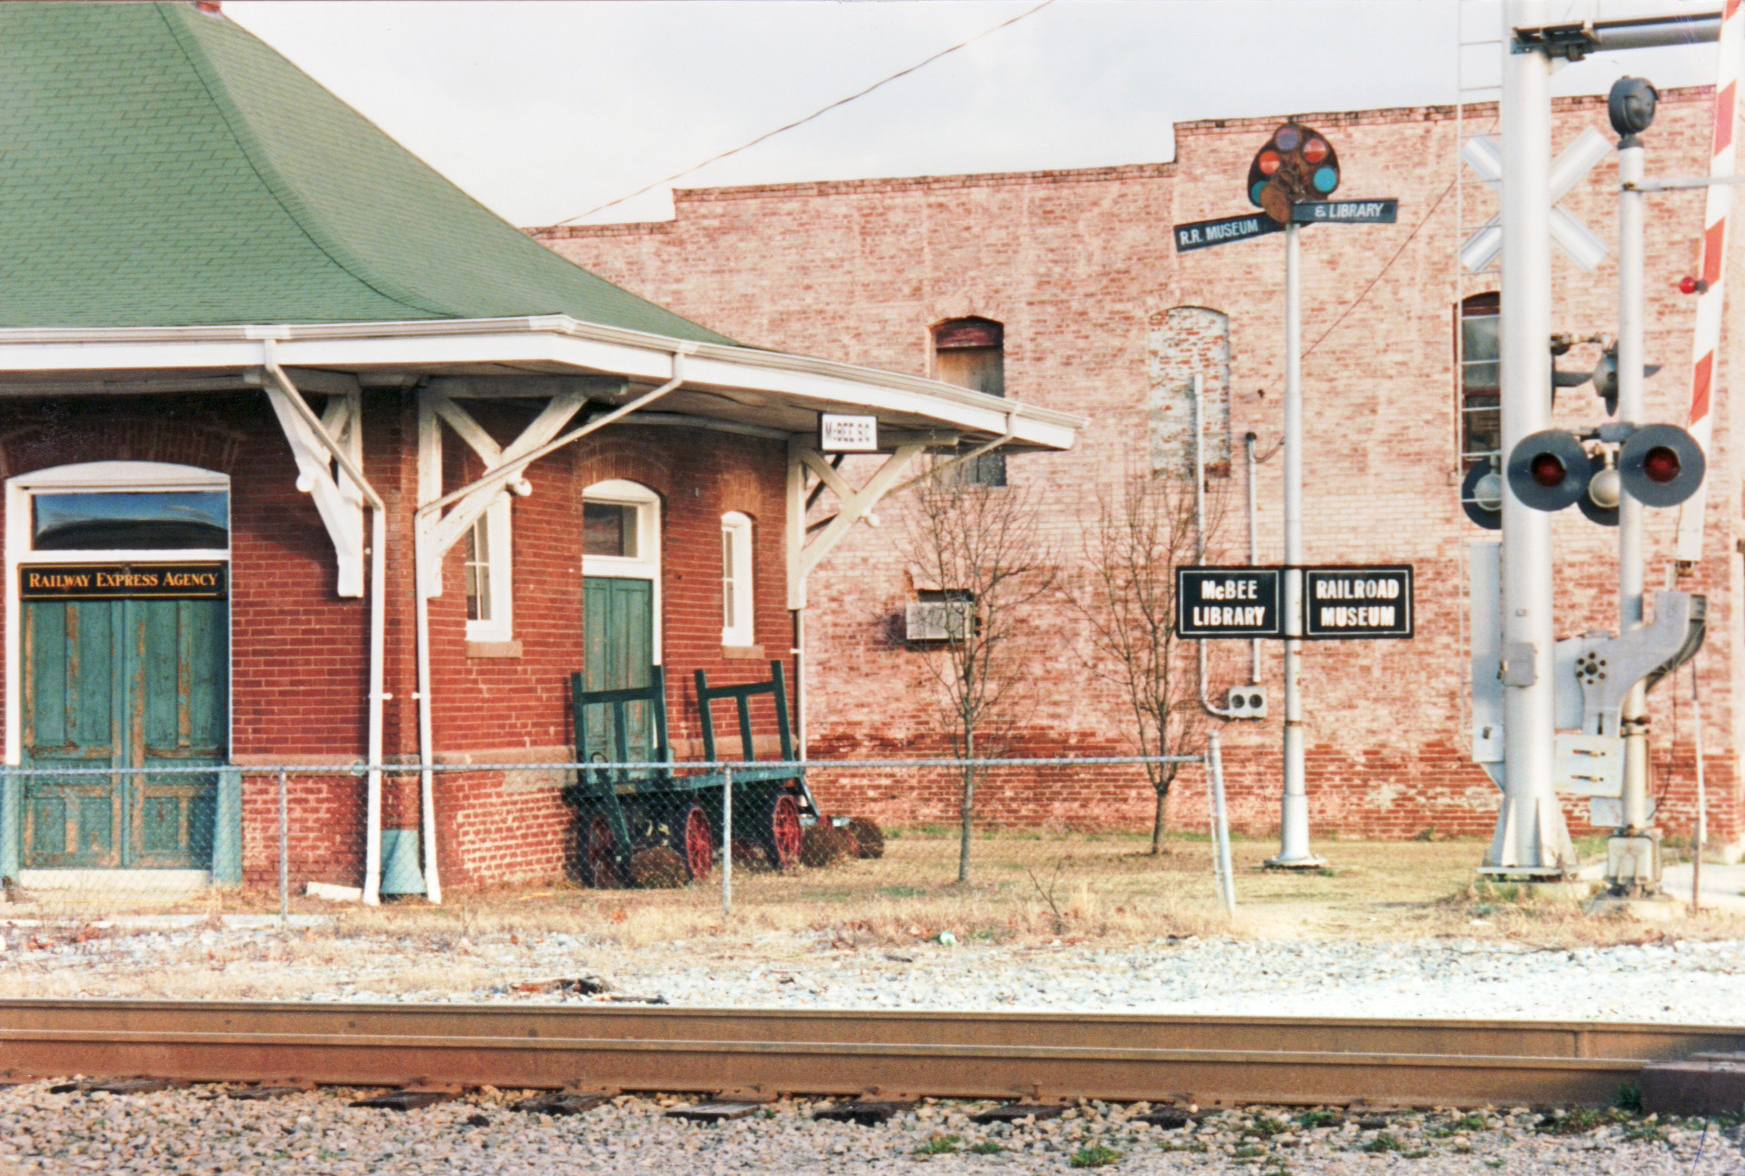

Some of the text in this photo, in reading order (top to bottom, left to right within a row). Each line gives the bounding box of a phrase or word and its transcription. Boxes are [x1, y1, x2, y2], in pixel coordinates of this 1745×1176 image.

[1314, 203, 1384, 218] & LIBRARY
[1179, 219, 1259, 245] R.R. MUSEUM
[1201, 580, 1258, 600] McBEE
[1316, 579, 1399, 599] RAILROAD
[1193, 606, 1265, 626] LIBRARY
[1321, 606, 1395, 627] MUSEUM
